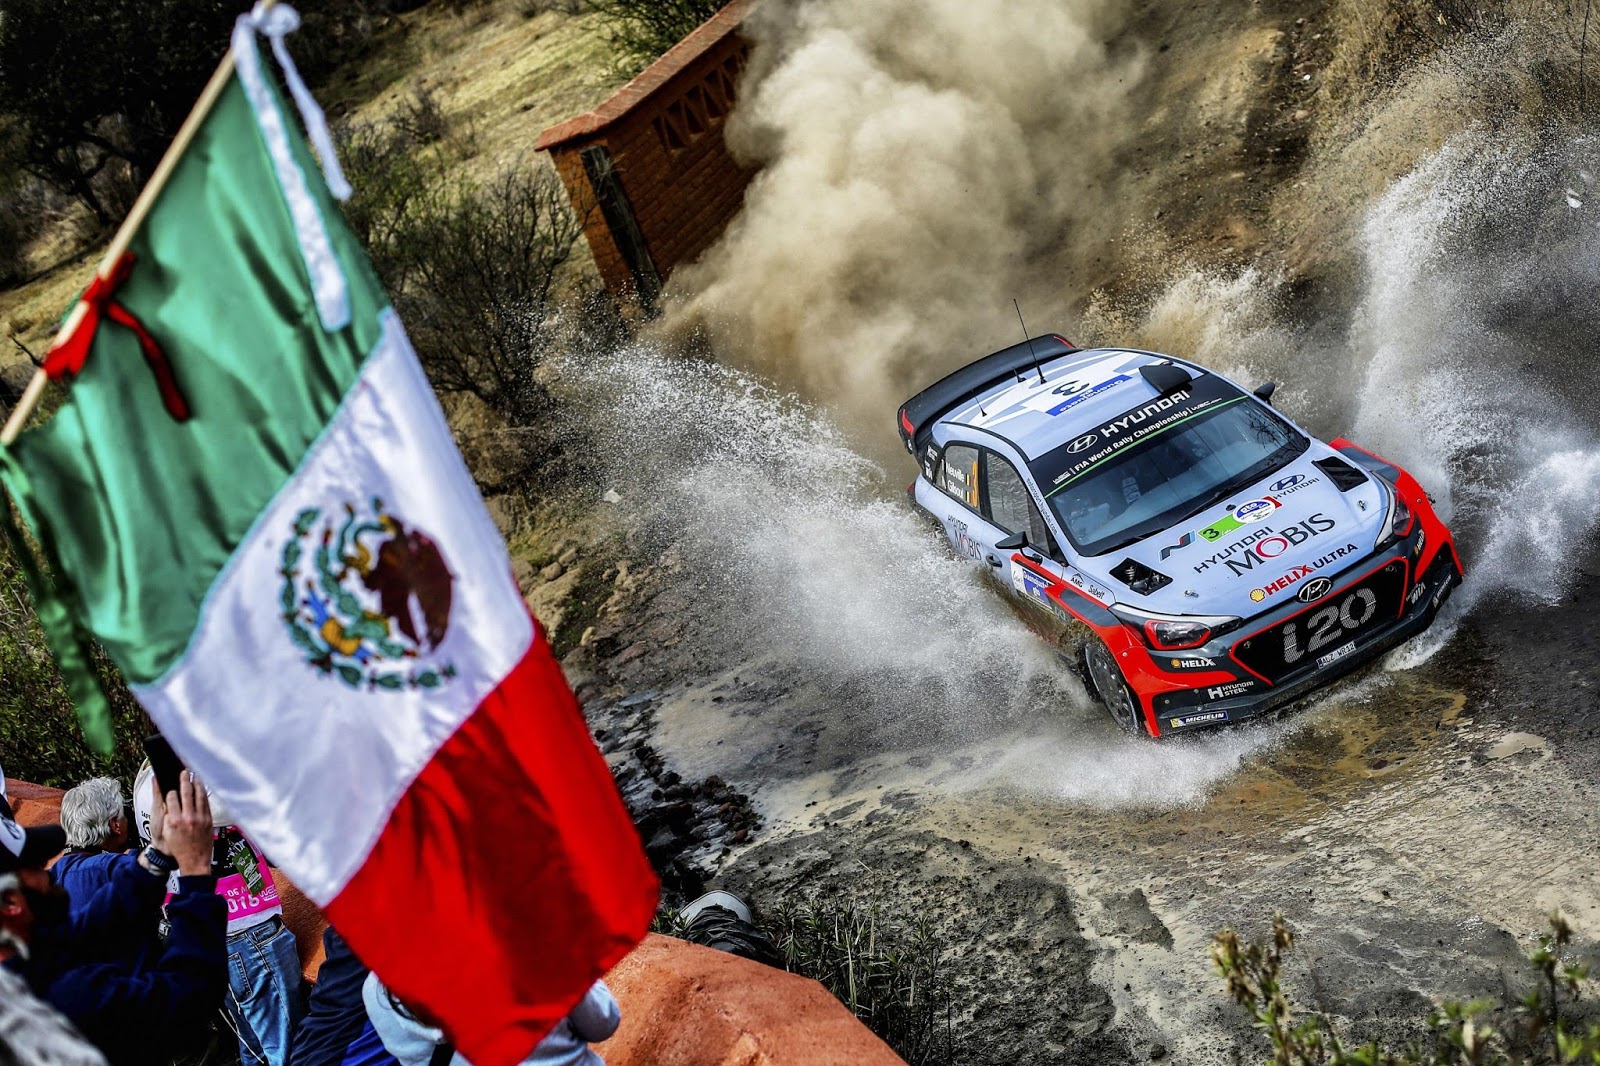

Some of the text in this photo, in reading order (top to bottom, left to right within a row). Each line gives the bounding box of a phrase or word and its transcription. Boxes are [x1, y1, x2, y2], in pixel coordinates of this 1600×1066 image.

[1100, 390, 1191, 438] HYUNDAI
[1075, 461, 1089, 472] FIA
[1088, 446, 1113, 463] World
[1112, 435, 1134, 450] Rally
[1133, 410, 1189, 438] Championship
[946, 462, 965, 482] Neuville
[947, 479, 964, 499] Gilsoul
[1273, 478, 1320, 499] HYUNDAI
[1202, 528, 1220, 539] 3
[1193, 526, 1274, 574] HYUNDAI
[1223, 512, 1336, 578] MOBIS
[1264, 543, 1359, 596] HELIX ULTRA
[1088, 584, 1105, 600] Sabelt
[1281, 587, 1377, 664] i20
[1181, 657, 1216, 668] HELIX
[1222, 681, 1254, 692] HYUNDAI
[1224, 687, 1248, 697] STEEL
[1185, 713, 1225, 723] MICHELIN
[227, 894, 260, 914] 016
